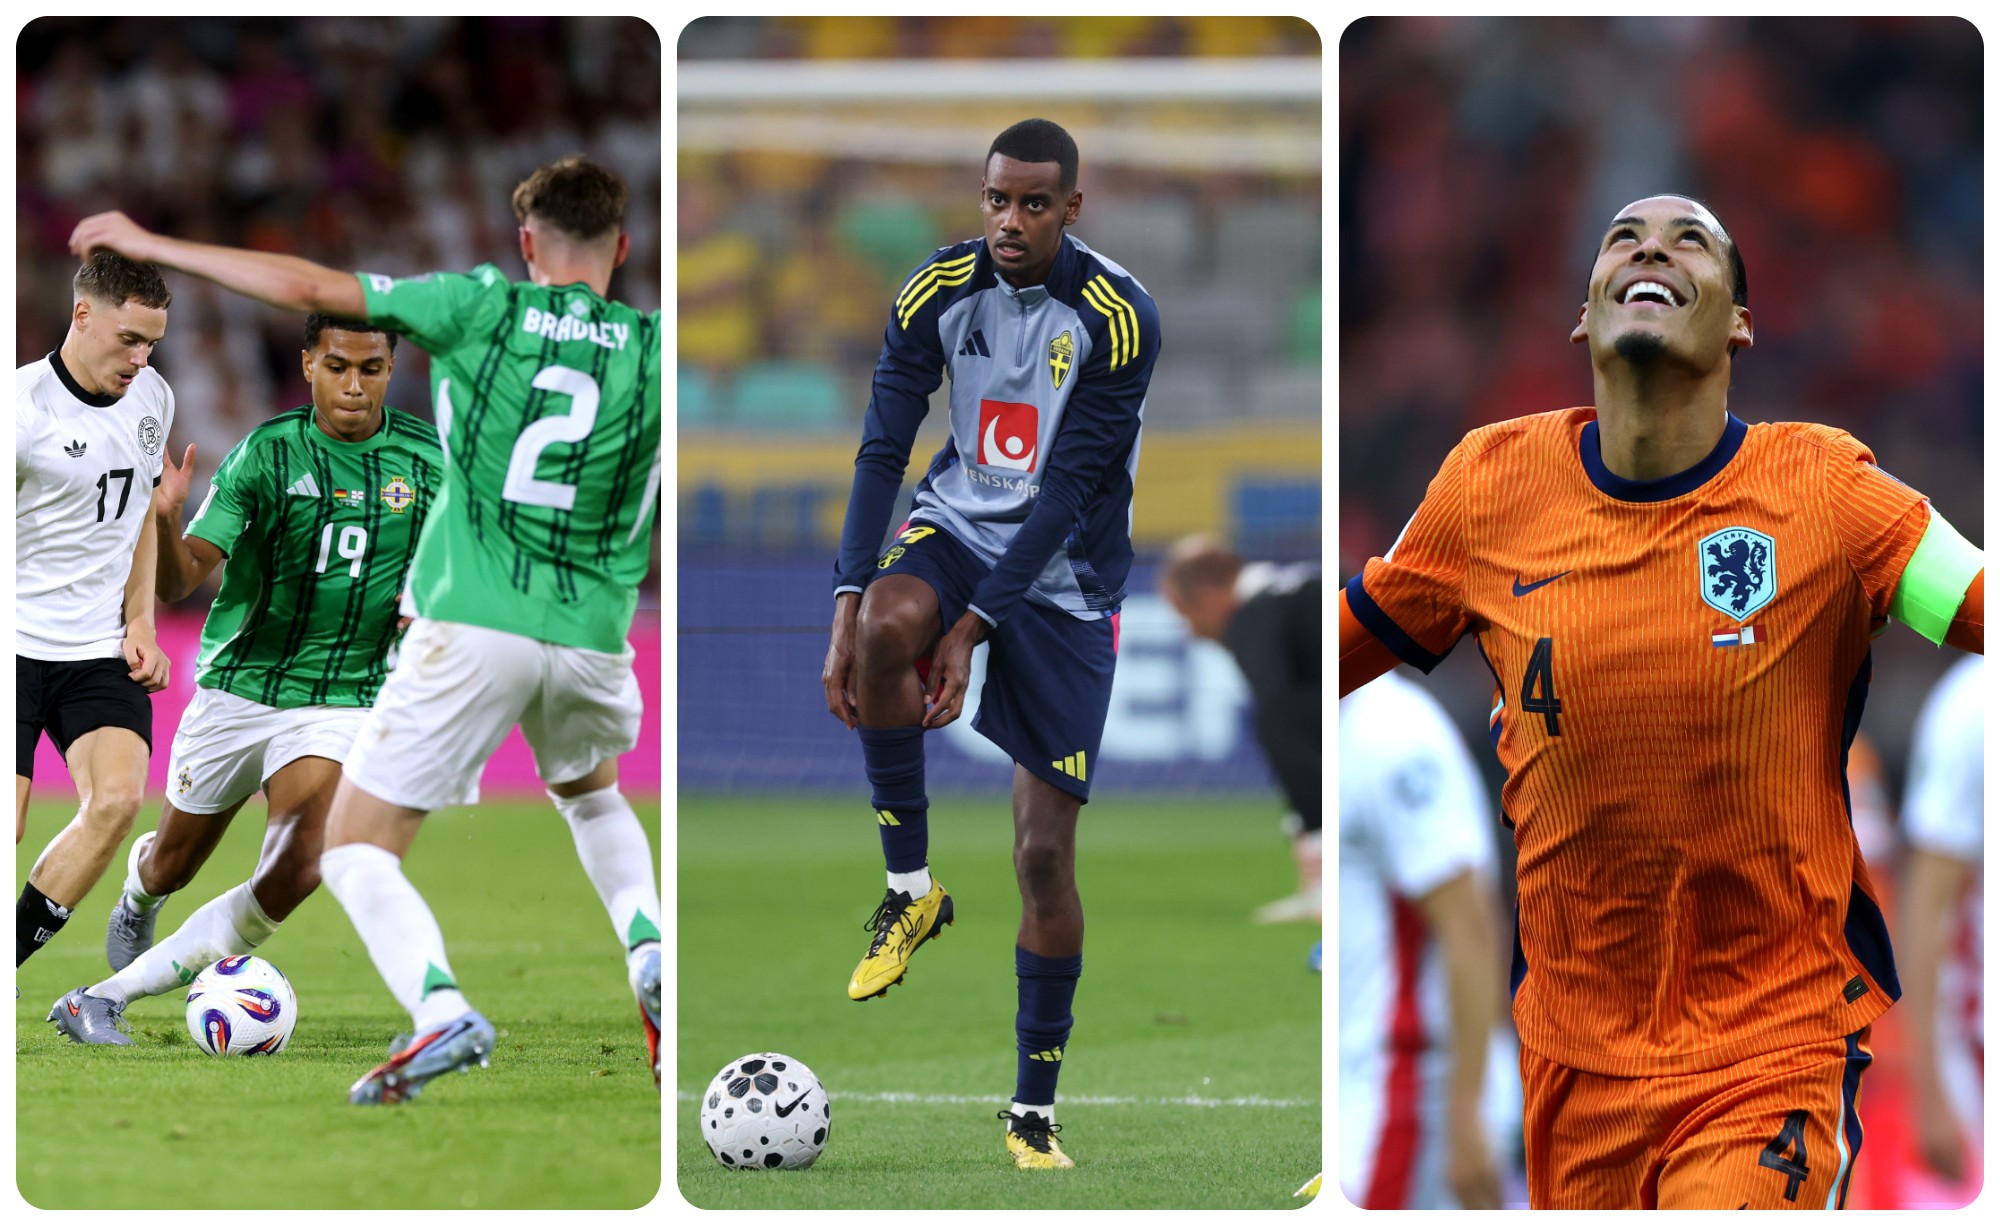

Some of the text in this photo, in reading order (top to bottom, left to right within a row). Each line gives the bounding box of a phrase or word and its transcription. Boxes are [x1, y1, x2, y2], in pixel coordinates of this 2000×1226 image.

[522, 306, 629, 351] BRADLEY
[501, 364, 600, 511] 2
[96, 467, 135, 523] 17
[314, 522, 368, 579] 19
[898, 526, 937, 544] 9
[1520, 637, 1563, 737] 4
[1757, 1108, 1811, 1203] 4
